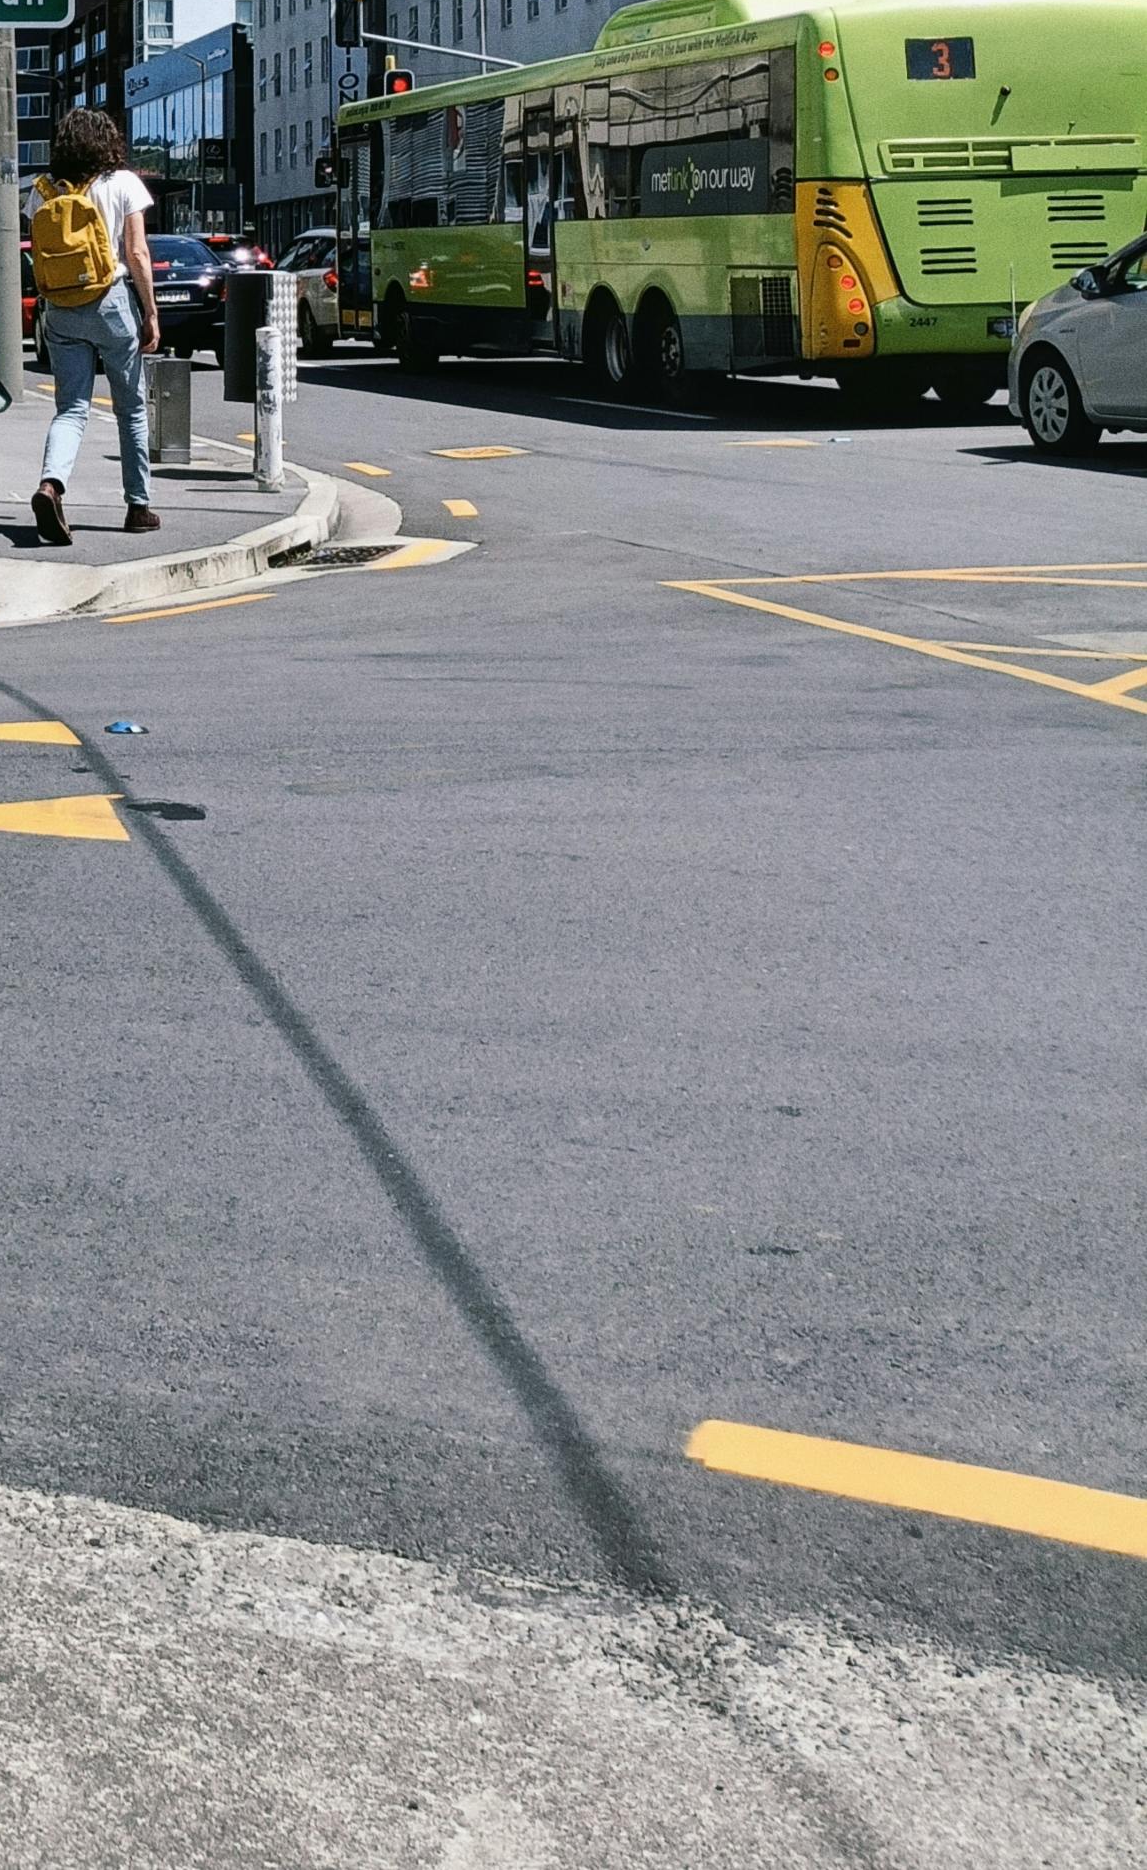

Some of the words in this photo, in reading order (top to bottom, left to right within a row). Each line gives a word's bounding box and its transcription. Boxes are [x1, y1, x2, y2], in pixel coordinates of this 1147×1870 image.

[931, 41, 951, 76] 3
[651, 166, 689, 192] metlink
[692, 168, 709, 191] on
[709, 168, 729, 189] our
[730, 166, 756, 192] way
[909, 317, 938, 328] 2447
